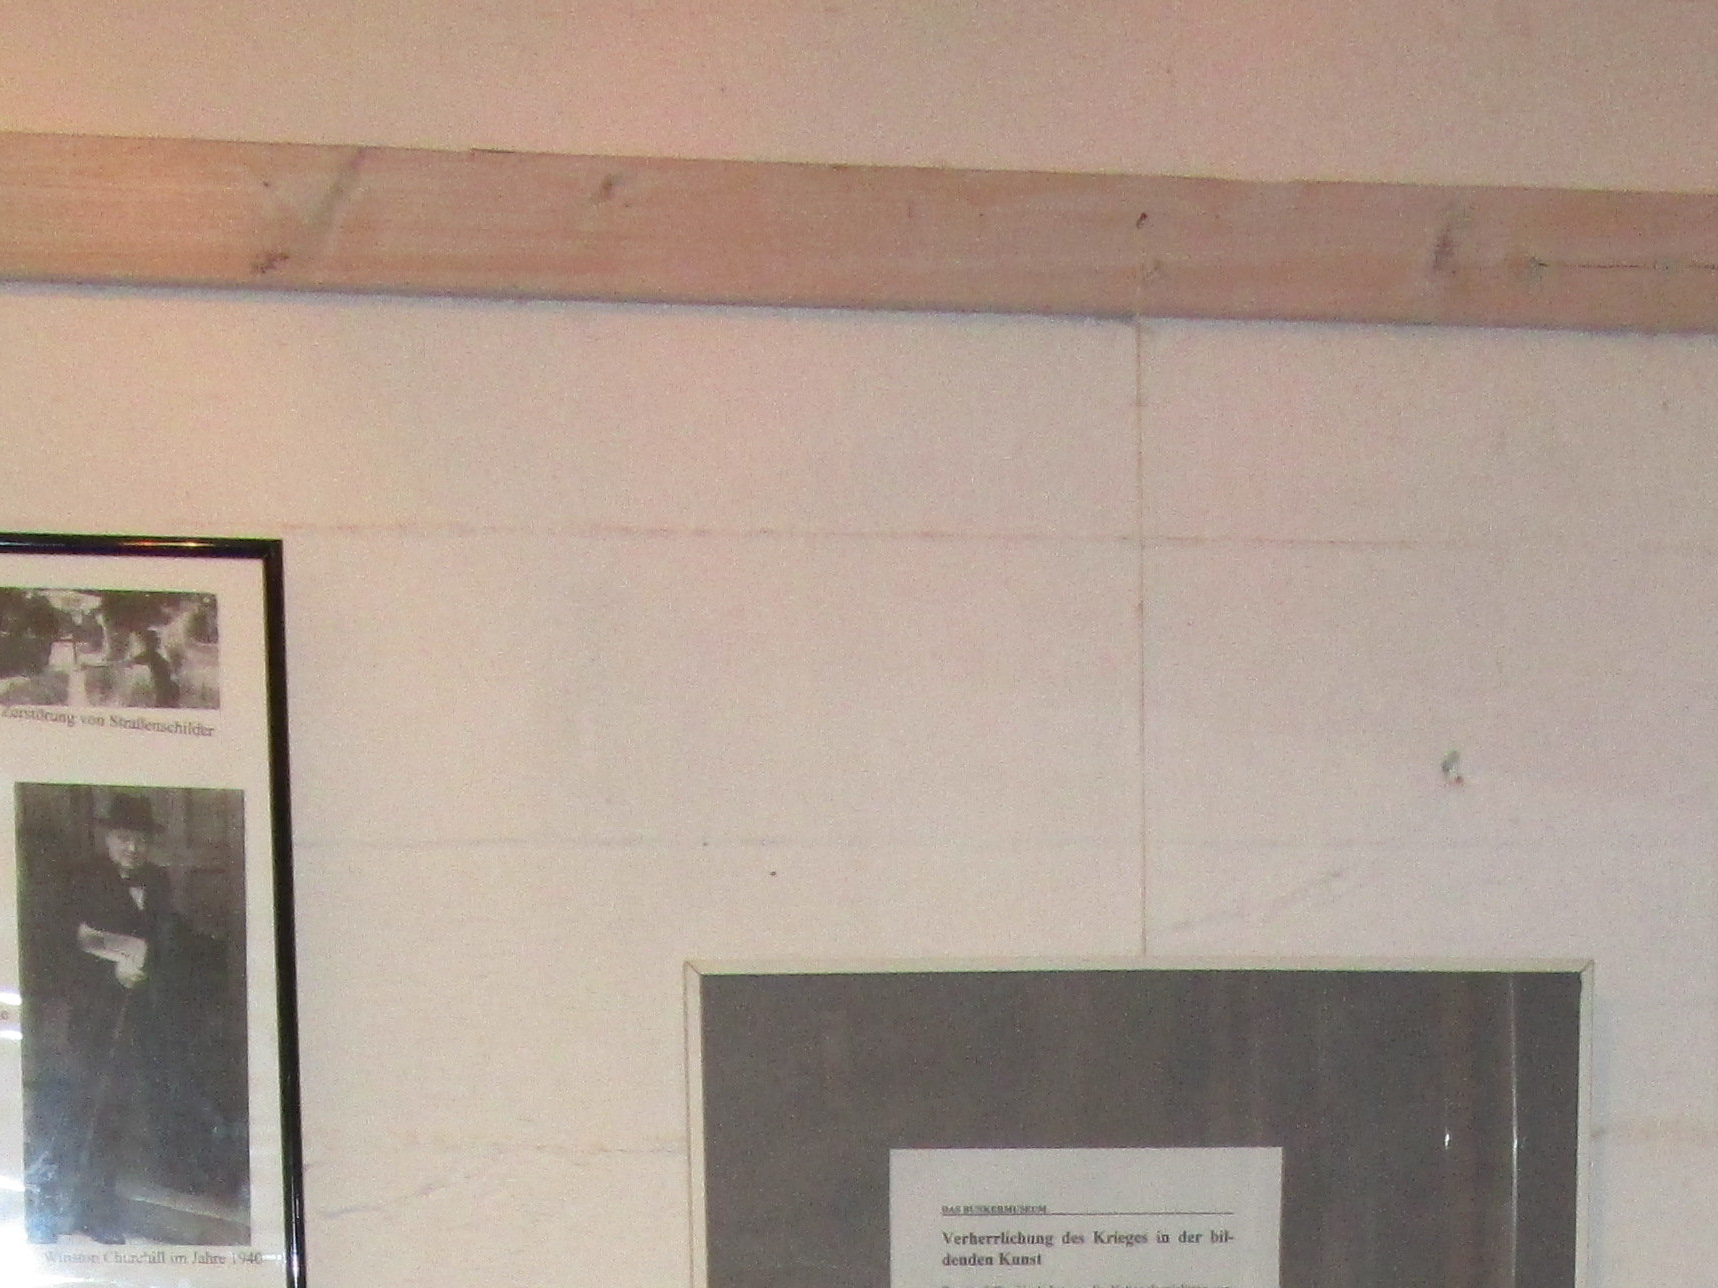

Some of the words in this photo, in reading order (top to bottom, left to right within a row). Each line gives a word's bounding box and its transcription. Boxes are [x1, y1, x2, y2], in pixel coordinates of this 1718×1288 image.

[81, 717, 104, 726] von
[942, 1231, 1053, 1248] Verherrlichung
[1062, 1231, 1084, 1244] des
[1094, 1231, 1148, 1247] Krieges
[1156, 1230, 1170, 1243] in
[1179, 1230, 1202, 1243] der
[1210, 1230, 1234, 1243] bil-
[192, 1251, 226, 1263] Jahre
[942, 1253, 993, 1265] denden
[1000, 1253, 1042, 1265] Kunst
